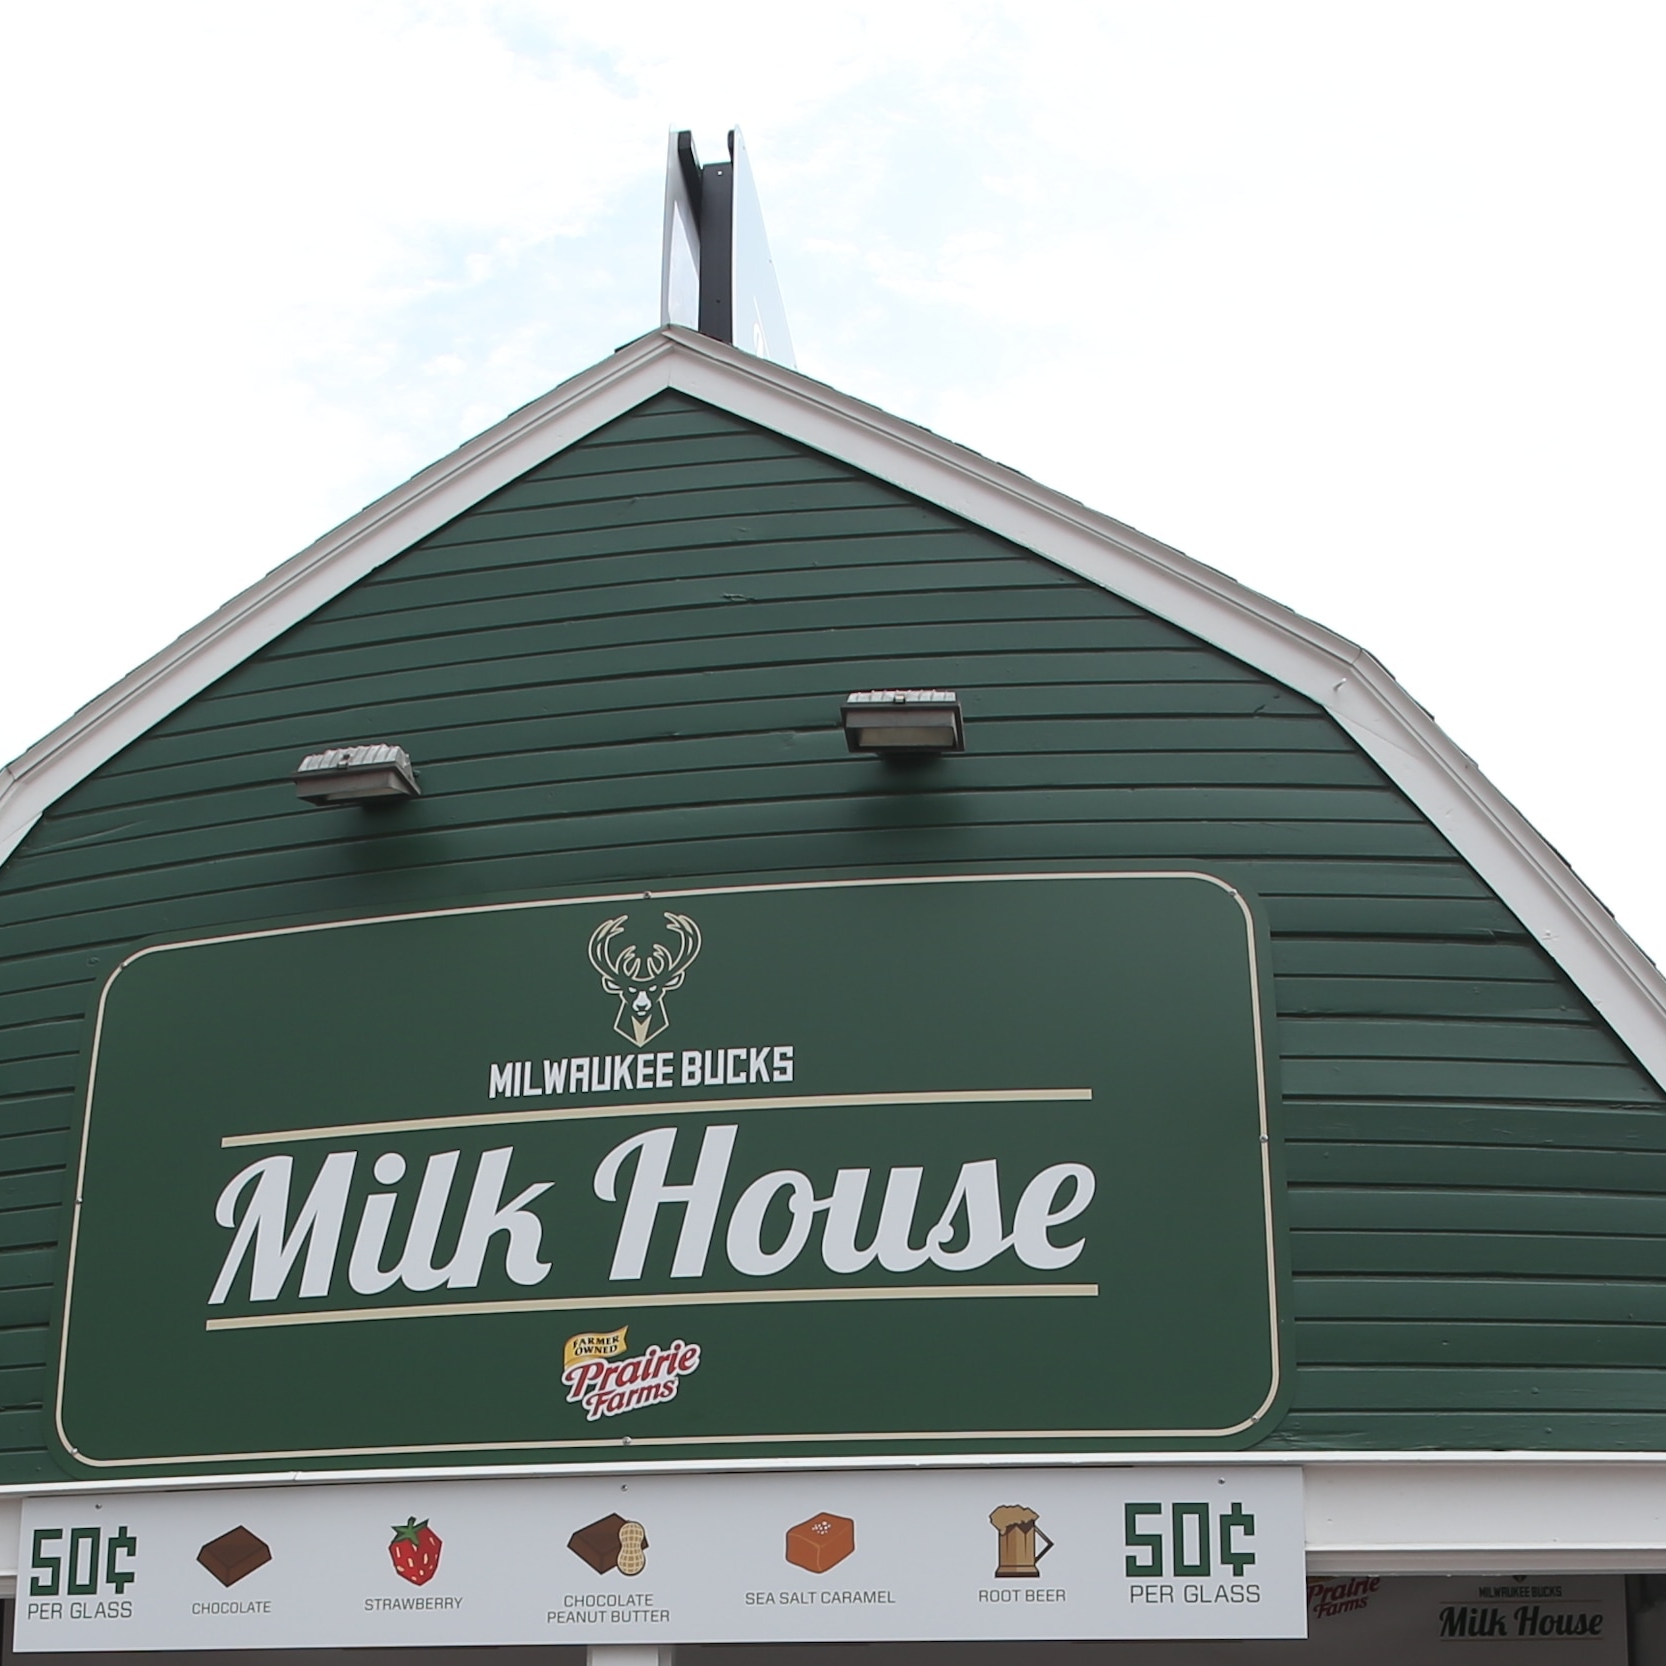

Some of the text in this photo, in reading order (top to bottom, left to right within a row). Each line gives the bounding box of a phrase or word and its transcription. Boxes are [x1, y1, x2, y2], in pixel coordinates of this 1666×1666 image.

[488, 1045, 795, 1100] MILWAUKEE BUCKS
[208, 1123, 1096, 1305] Milk House
[573, 1335, 620, 1356] FARMER OWNED
[564, 1342, 698, 1399] Prairie
[585, 1379, 677, 1418] Farms
[1123, 1501, 1256, 1578] 50¢
[28, 1525, 138, 1597] 50¢
[562, 1593, 655, 1609] CHOCOLATE
[744, 1590, 896, 1606] SEA SALT CARAMEL
[978, 1588, 1067, 1604] ROOT BEER
[1130, 1583, 1262, 1605] PER GLASS
[1478, 1586, 1563, 1599] MILWAUKEE BUCKS
[27, 1600, 134, 1622] PER GLASS
[191, 1600, 272, 1615] CHOCOLATE
[363, 1596, 464, 1612] STRAWBERRY
[1313, 1596, 1369, 1619] Farms
[546, 1608, 671, 1625] PEANUT BUTTER
[1439, 1605, 1604, 1638] Milk House
